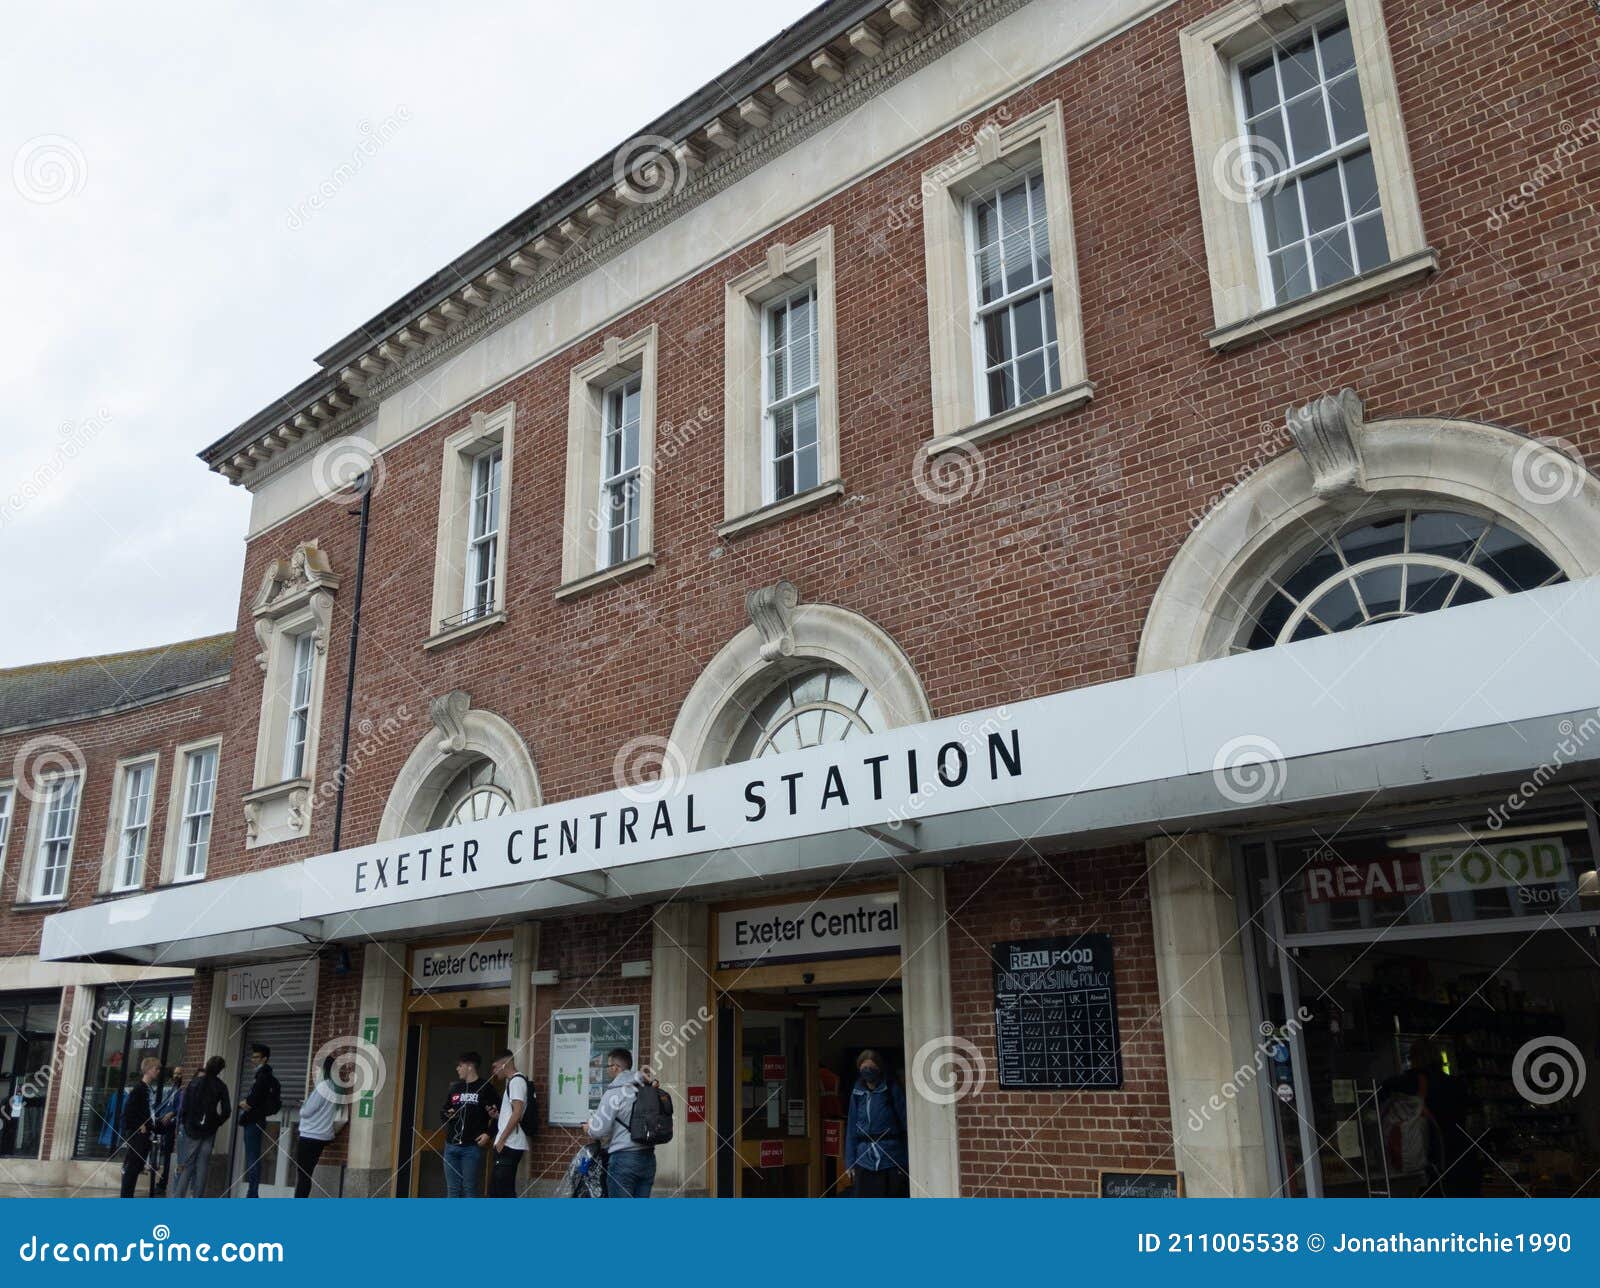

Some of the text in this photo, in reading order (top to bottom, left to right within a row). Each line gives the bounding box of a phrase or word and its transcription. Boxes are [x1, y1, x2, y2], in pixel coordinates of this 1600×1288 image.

[355, 729, 1023, 894] EXETER CENTRAL STATION
[1301, 848, 1334, 862] The
[1307, 843, 1562, 900] REAL FOOD
[1517, 885, 1570, 905] Store
[735, 902, 898, 946] Exeter Central
[423, 949, 513, 976] Exeter Centr
[1011, 948, 1093, 968] REAL FOOD
[998, 970, 1111, 991] PURCHASING POLICY
[688, 1104, 705, 1113] ONLY
[689, 1095, 703, 1103] EXIT
